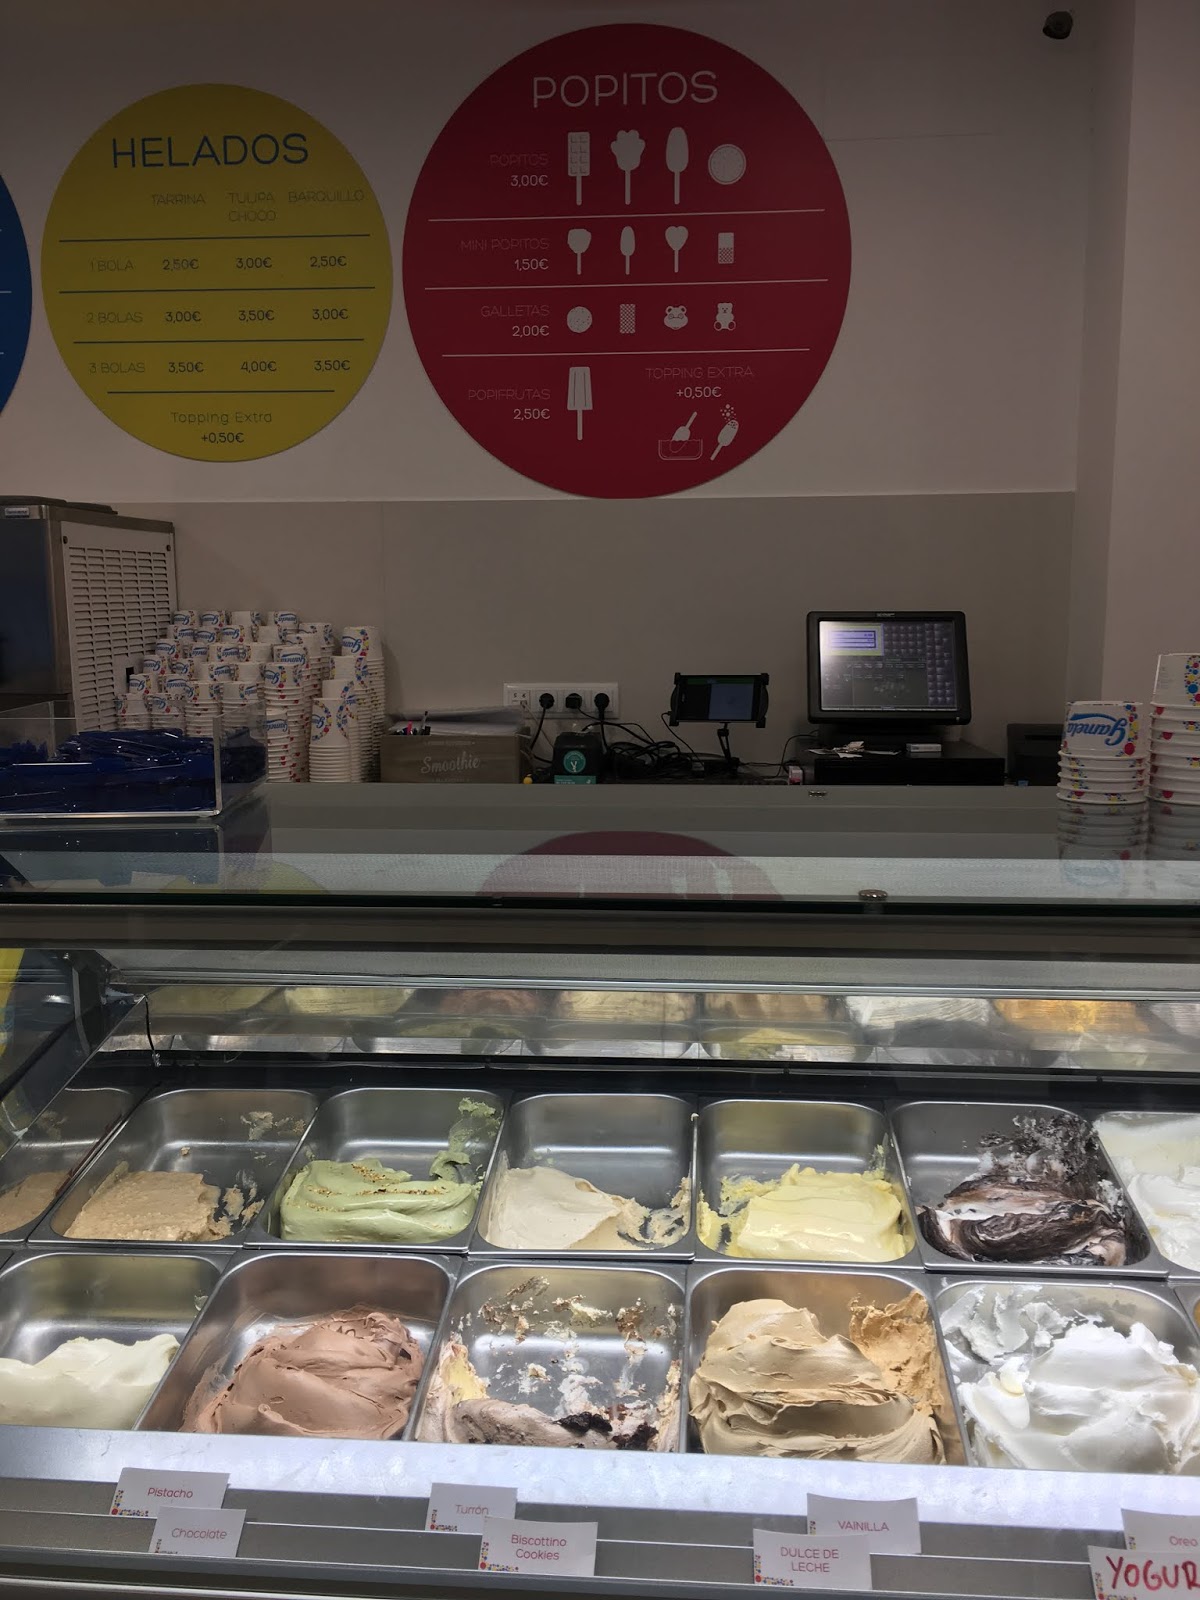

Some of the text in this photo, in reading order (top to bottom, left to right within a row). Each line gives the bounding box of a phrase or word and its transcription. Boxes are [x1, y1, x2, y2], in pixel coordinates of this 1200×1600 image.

[531, 70, 719, 109] POPITOS
[112, 132, 310, 168] HELADOS
[489, 153, 549, 166] POPITOS
[510, 175, 549, 188] 3,00€
[151, 193, 206, 206] TARRINA
[288, 189, 365, 203] BARQUILLO
[228, 210, 276, 222] CHOCO
[460, 238, 550, 251] MINI POPITOS
[97, 259, 135, 271] BOLA
[162, 259, 199, 272] 2,50€
[235, 257, 273, 270] 3,00€
[310, 255, 347, 269] 2,50€
[514, 259, 550, 272] 1,50€
[87, 308, 349, 323] 2 BOLAS 3,00€ 3,50€ 3,00€
[480, 304, 550, 317] GALLETAS
[511, 325, 550, 339] 2,00€
[89, 359, 351, 374] 3 BOLAS 3,50€ 4,00€ 3,50€
[645, 366, 754, 380] TOPPING EXTRA
[676, 385, 722, 399] +0,50€
[170, 411, 273, 425] Topping Extra
[513, 408, 551, 421] 2,50€
[200, 432, 245, 444] +0,50€
[420, 751, 481, 774] Smoothie
[147, 1487, 194, 1499] Pistacho
[455, 1504, 489, 1516] Turrón
[837, 1520, 890, 1532] VAINILLA
[171, 1527, 228, 1540] Chocolate
[511, 1534, 567, 1547] Biscottino
[1169, 1535, 1199, 1547] Oreo
[515, 1548, 560, 1561] Cookies
[780, 1546, 839, 1559] DULCE DE
[791, 1561, 831, 1573] LECHE
[1105, 1556, 1200, 1591] YOGUR
